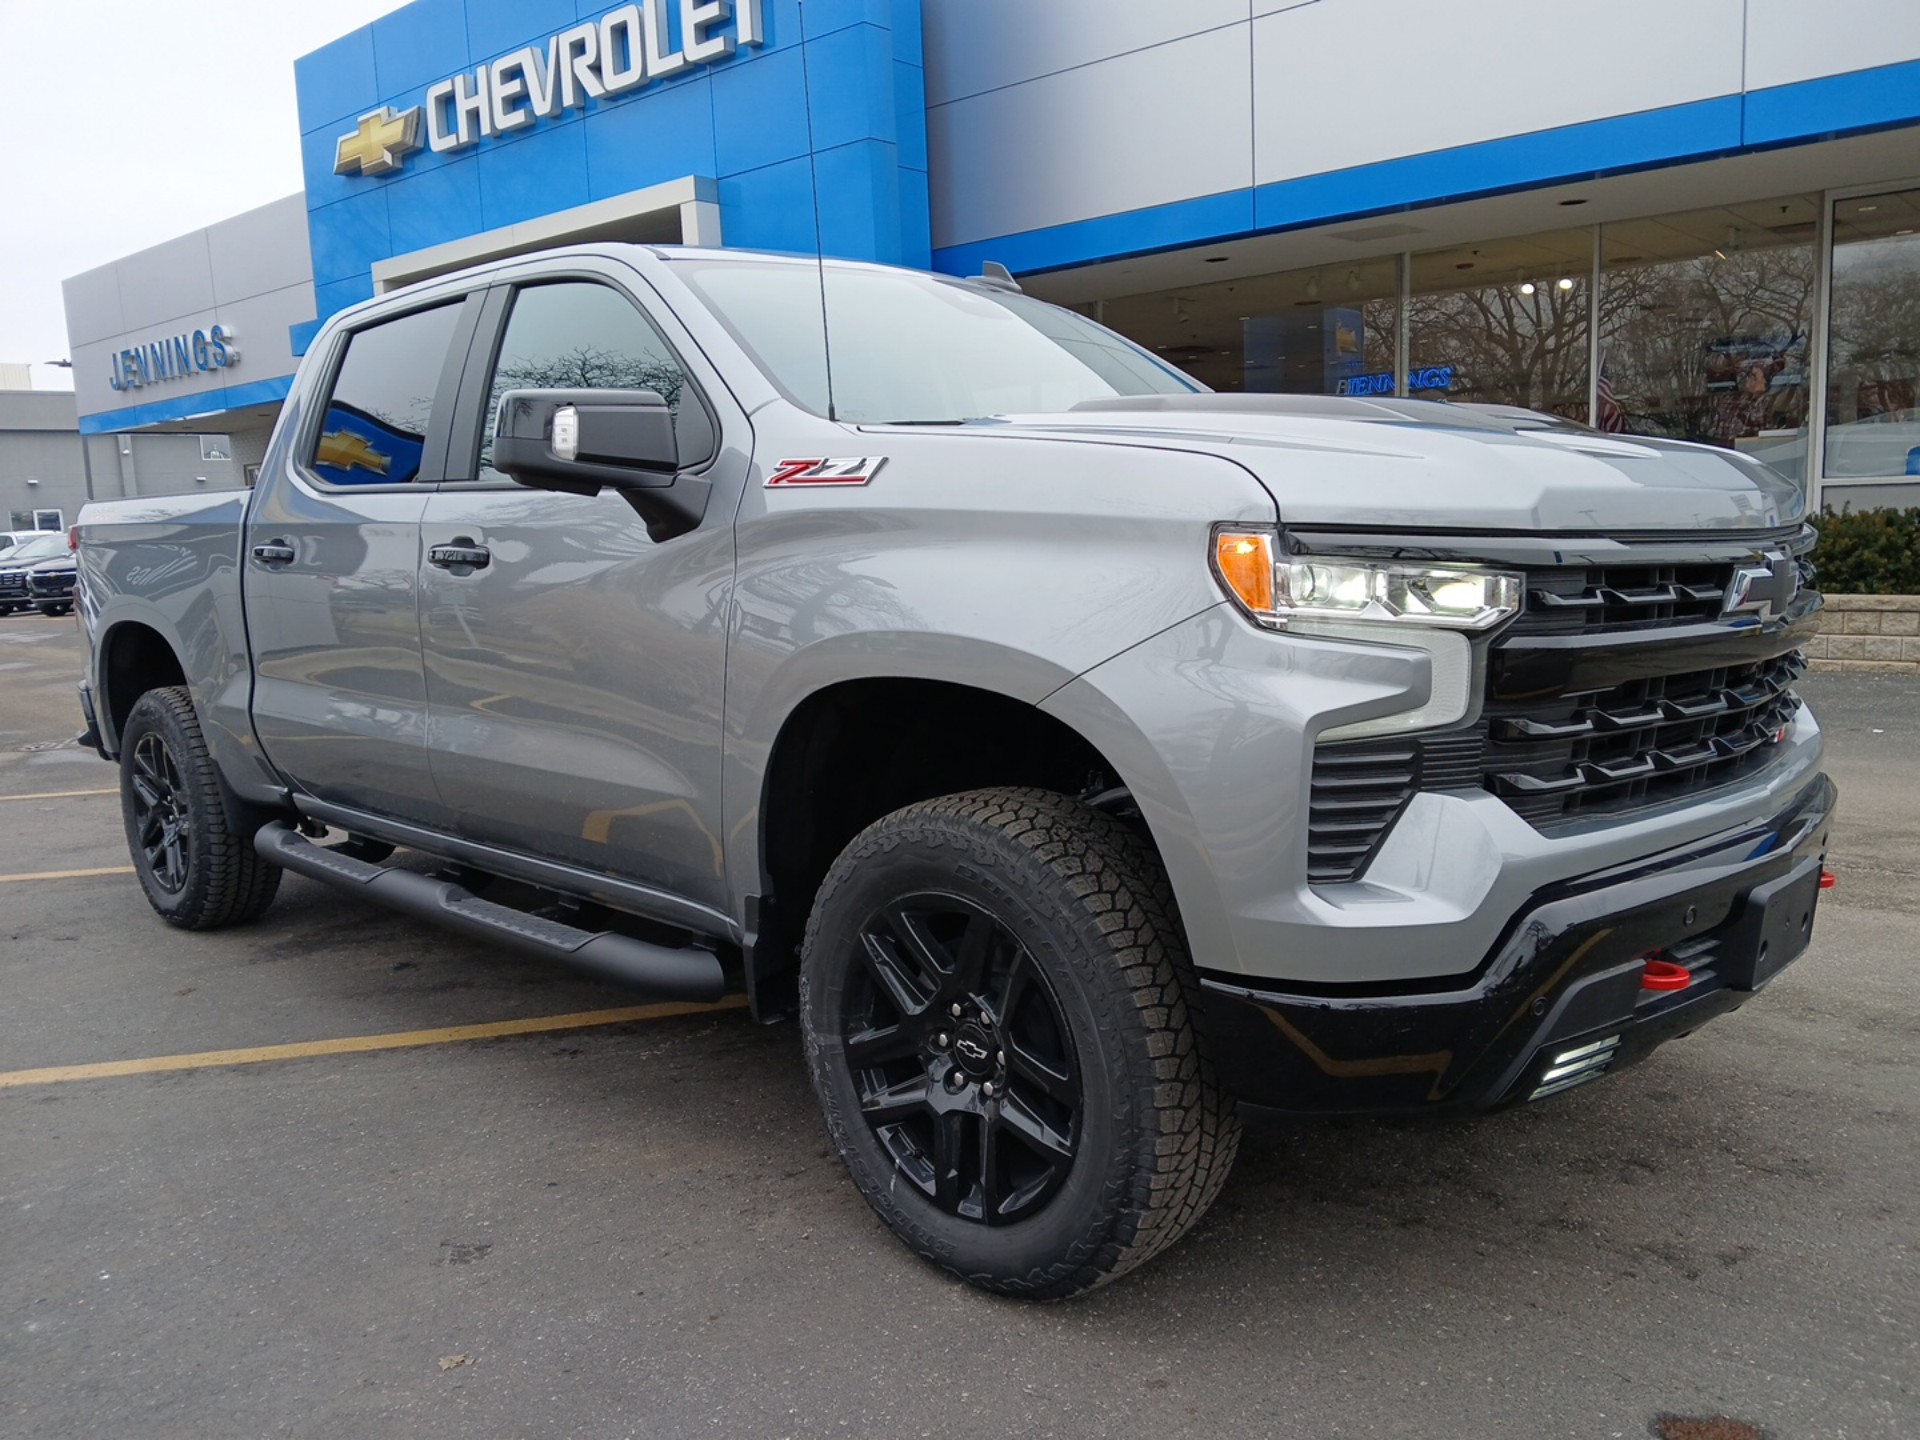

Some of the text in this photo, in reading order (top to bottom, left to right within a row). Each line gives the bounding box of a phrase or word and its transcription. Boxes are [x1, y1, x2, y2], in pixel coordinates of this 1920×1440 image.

[109, 325, 231, 391] JENNINGS
[1348, 367, 1451, 395] JENNNGS
[763, 457, 888, 488] Z71
